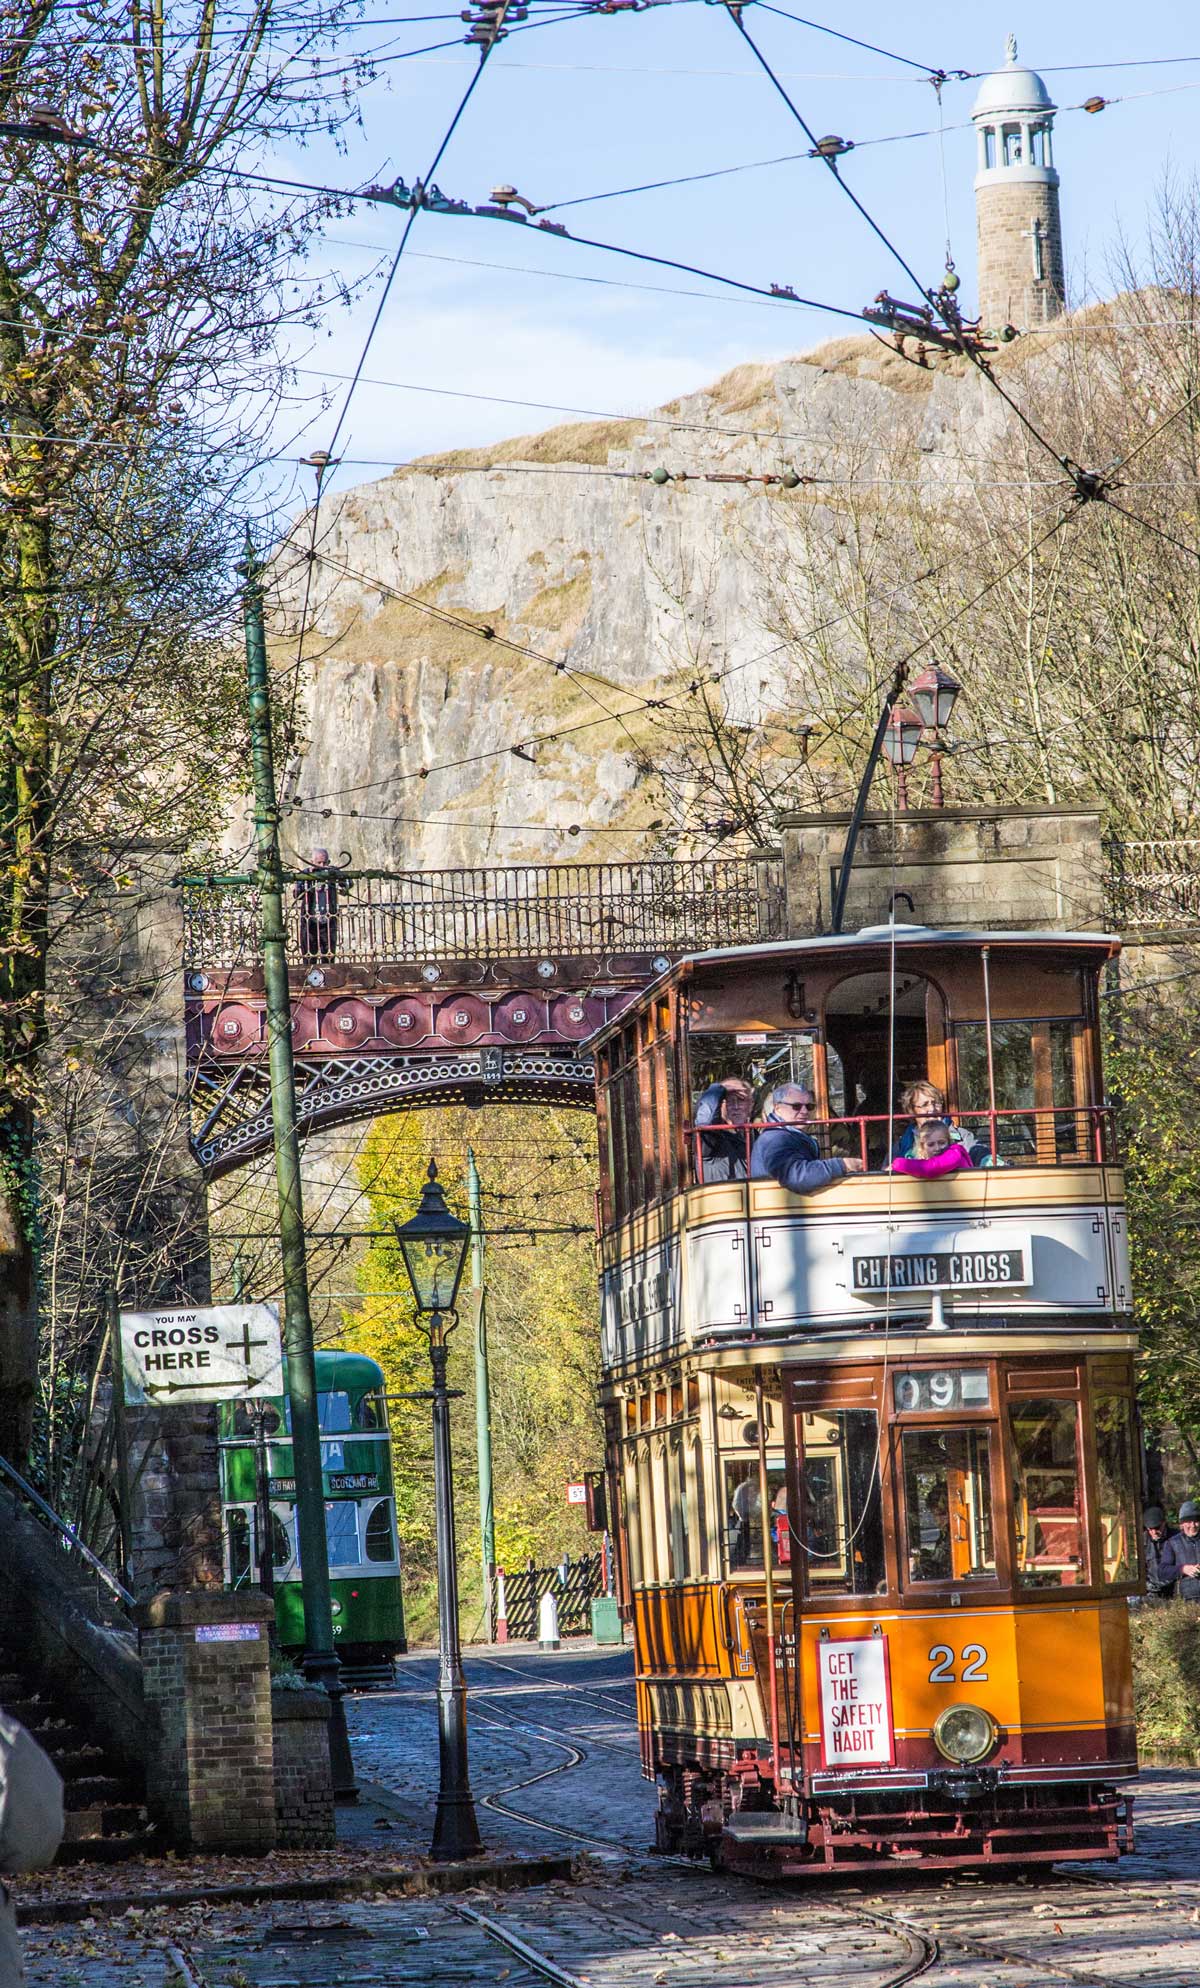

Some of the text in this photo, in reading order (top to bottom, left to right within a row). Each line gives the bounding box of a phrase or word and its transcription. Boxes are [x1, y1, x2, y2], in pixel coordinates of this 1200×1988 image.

[856, 1253, 1012, 1287] CHARING CROSS
[155, 1314, 197, 1325] YOU MAY
[134, 1325, 220, 1348] CROSS
[144, 1350, 212, 1371] HERE
[828, 1652, 855, 1675] GET
[928, 1643, 989, 1684] 22
[830, 1678, 859, 1701] THE
[831, 1703, 883, 1728] SAFETY
[833, 1729, 876, 1753] HABIT
